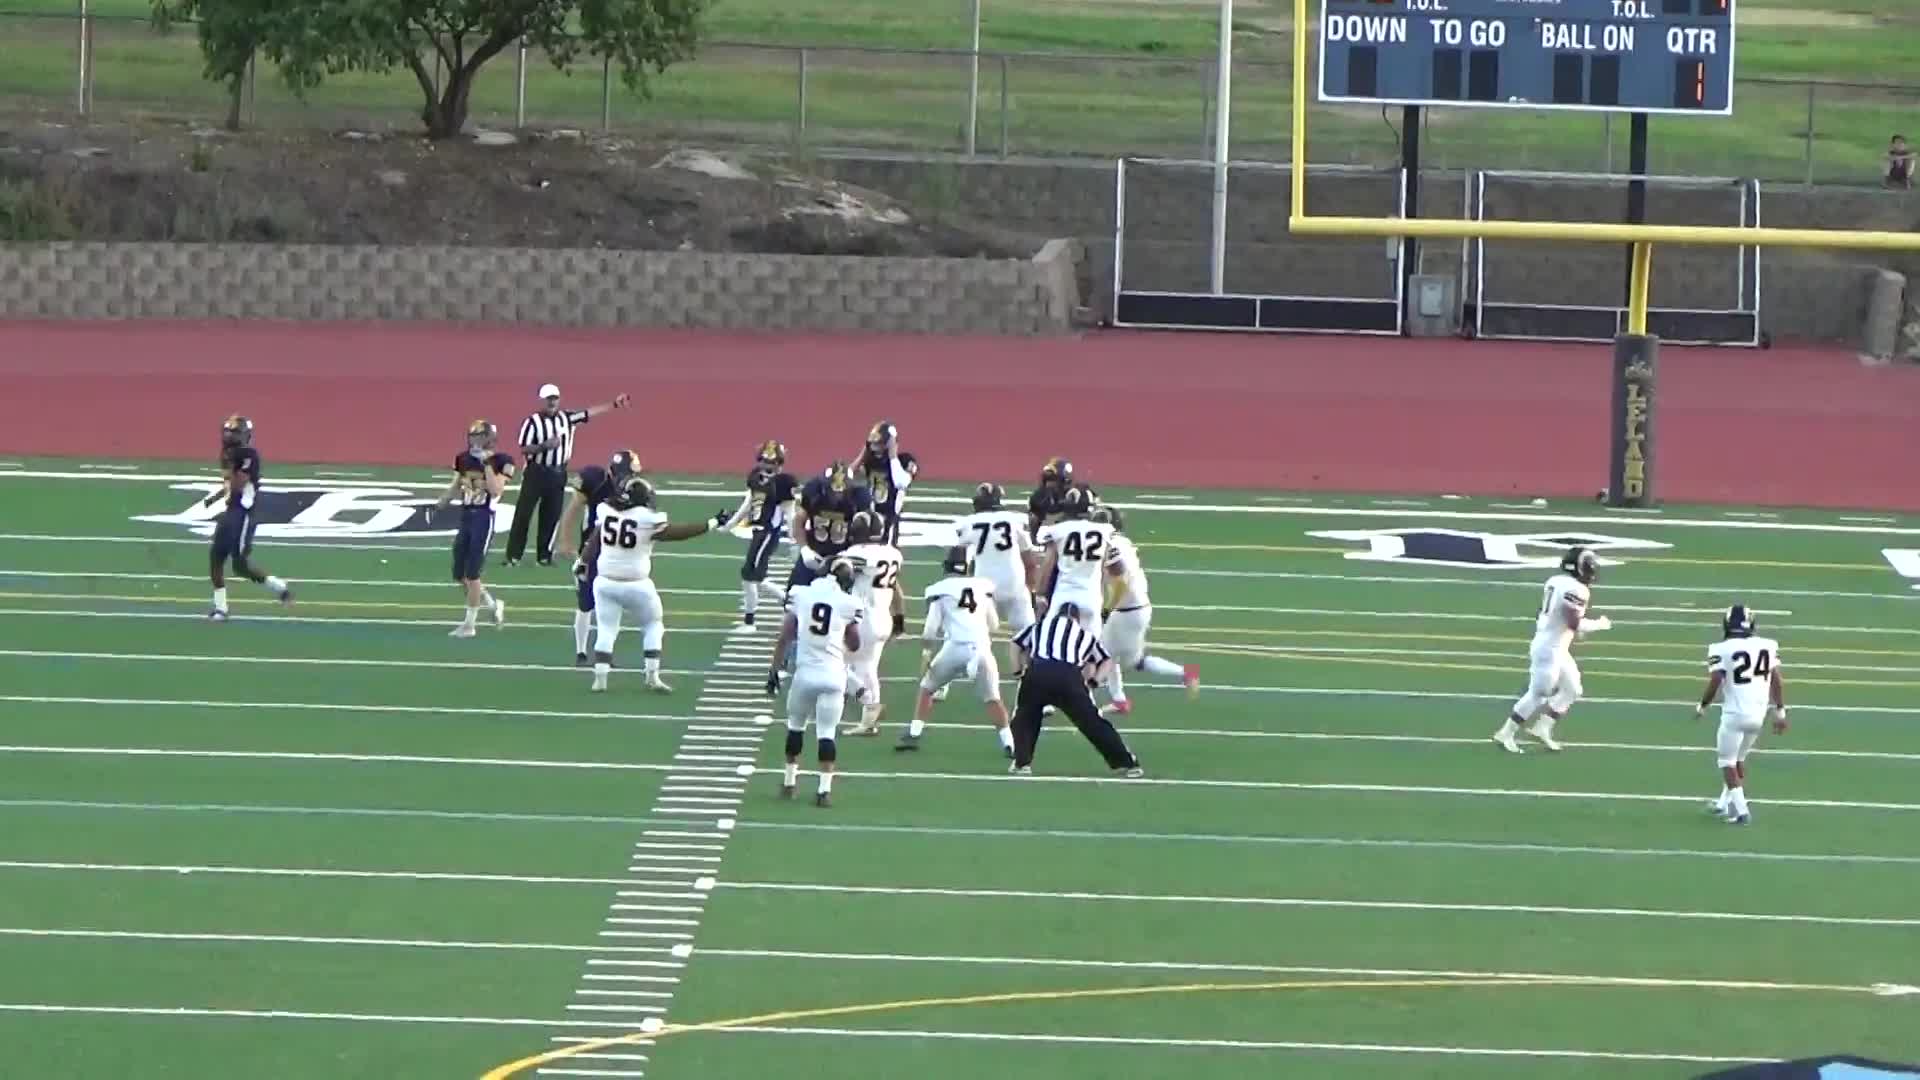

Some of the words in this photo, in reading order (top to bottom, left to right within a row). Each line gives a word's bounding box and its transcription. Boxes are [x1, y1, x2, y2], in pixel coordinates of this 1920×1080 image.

[1611, 0, 1655, 18] T.O.L.
[1327, 15, 1406, 42] DOWN
[1429, 19, 1462, 44] TO
[1470, 20, 1506, 46] GO
[1542, 23, 1597, 50] BALL
[1603, 25, 1635, 51] ON
[1666, 27, 1717, 54] QTR
[1694, 61, 1705, 104] 1
[1623, 383, 1647, 498] LELAND
[603, 516, 638, 549] 56
[971, 521, 1013, 556] 73
[1063, 530, 1103, 562] 42
[872, 560, 899, 589] 22
[958, 587, 977, 614] 4
[809, 603, 833, 636] 9
[1731, 649, 1770, 685] 24
